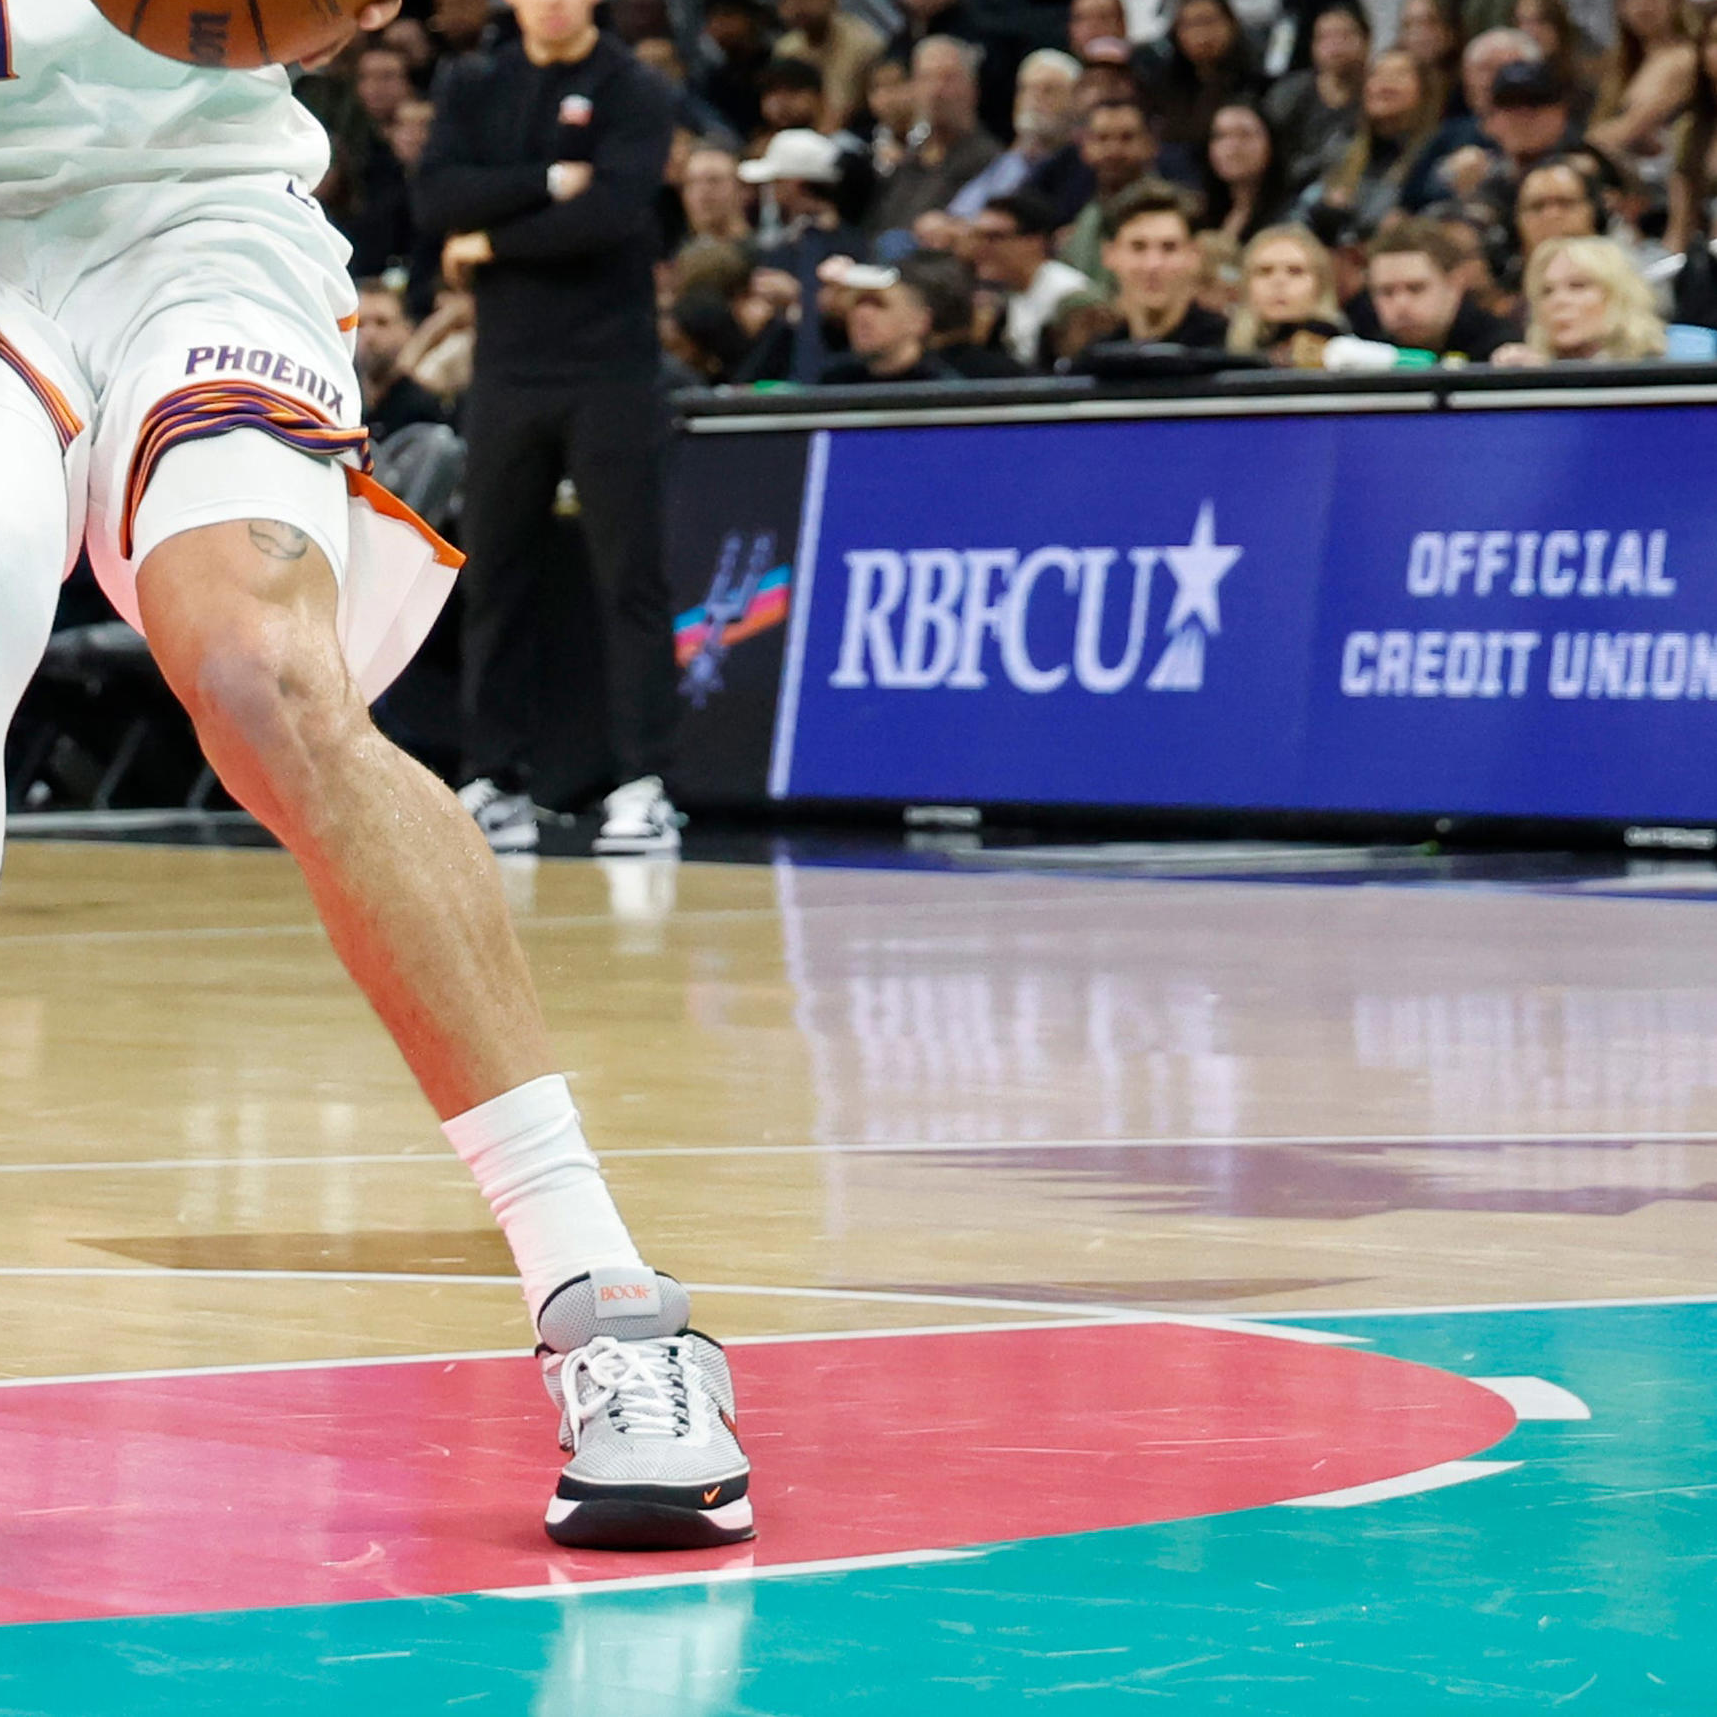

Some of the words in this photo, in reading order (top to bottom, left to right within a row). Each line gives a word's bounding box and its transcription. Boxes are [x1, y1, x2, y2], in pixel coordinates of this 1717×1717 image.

[184, 344, 344, 423] PHOENIX
[1405, 528, 1678, 597] OFFICIAL
[828, 543, 1162, 694] RBFCU
[1339, 629, 1543, 699] CREDIT
[1547, 630, 1717, 701] UNION
